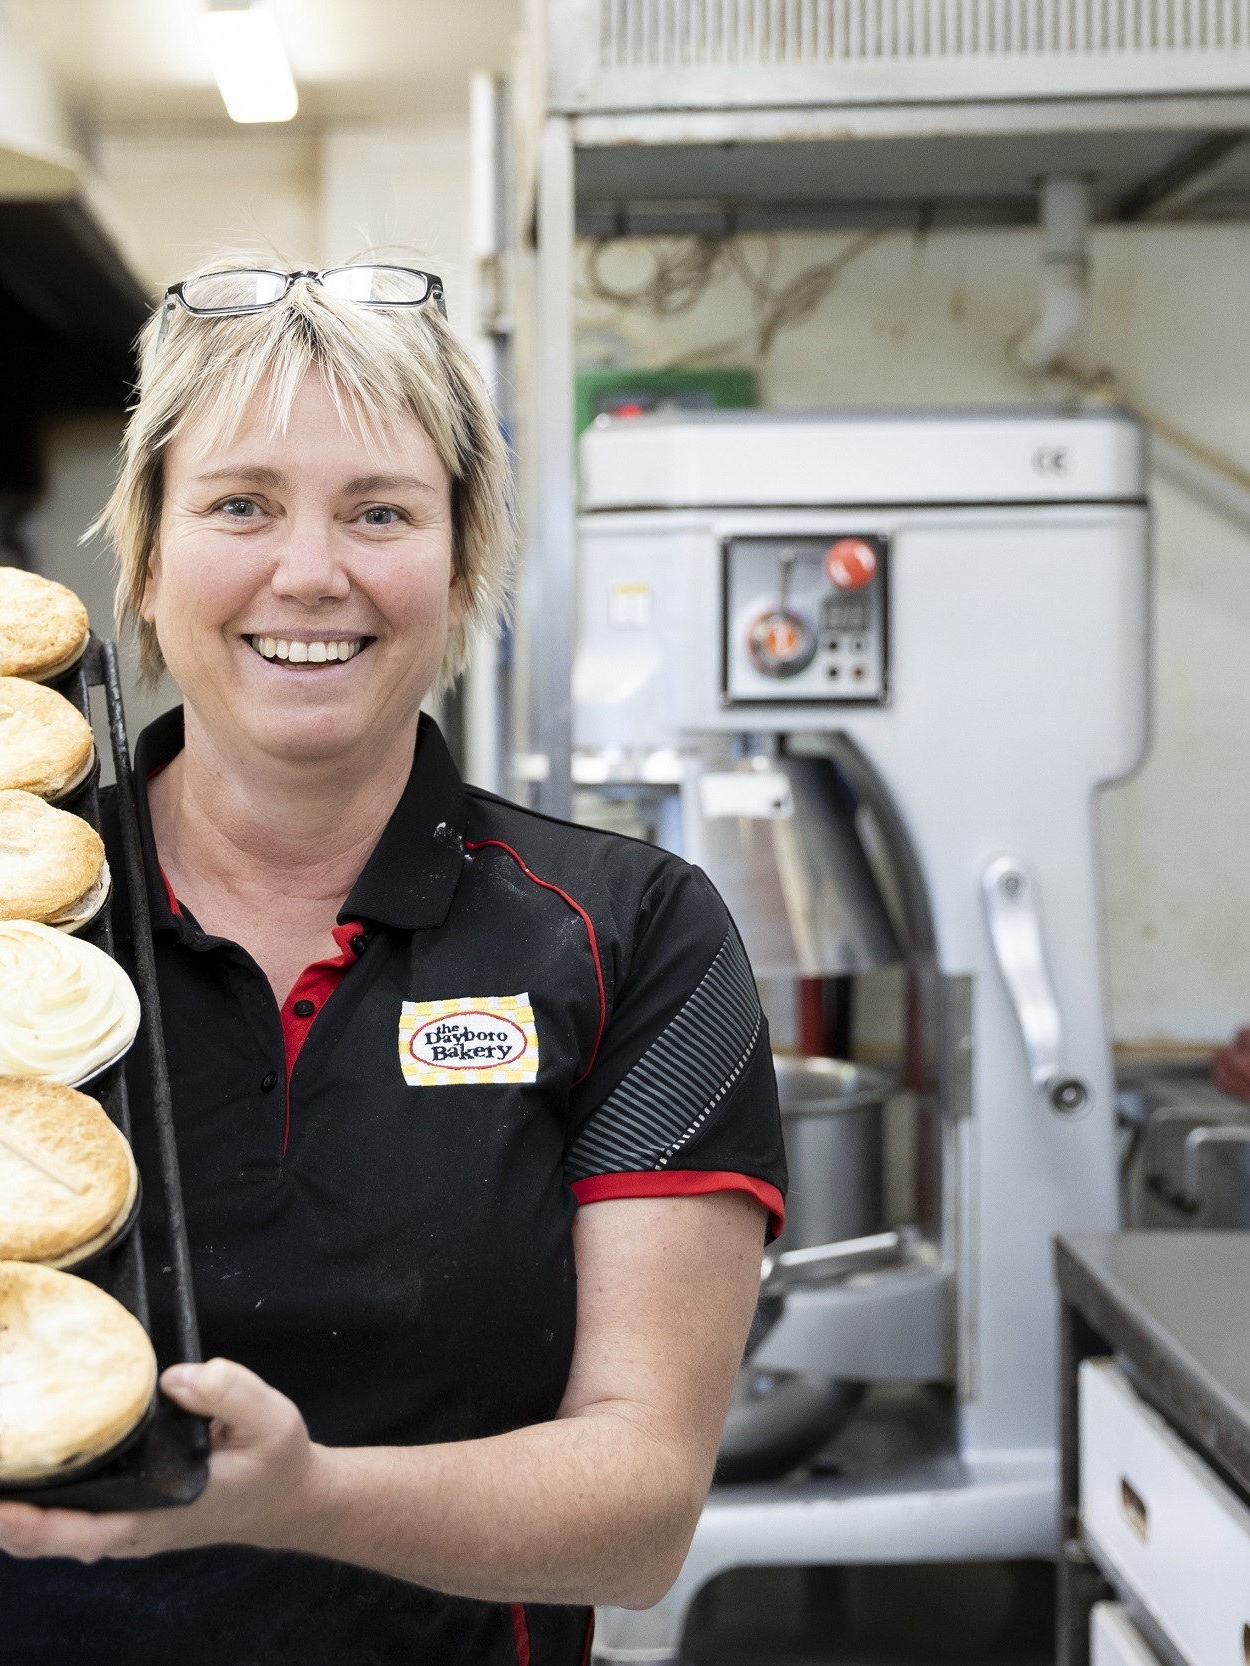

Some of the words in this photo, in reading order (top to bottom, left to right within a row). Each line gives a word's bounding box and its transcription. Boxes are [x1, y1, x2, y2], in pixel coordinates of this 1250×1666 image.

[425, 1026, 508, 1046] Dayboro
[436, 1024, 459, 1034] the
[431, 1043, 512, 1061] Bakery
